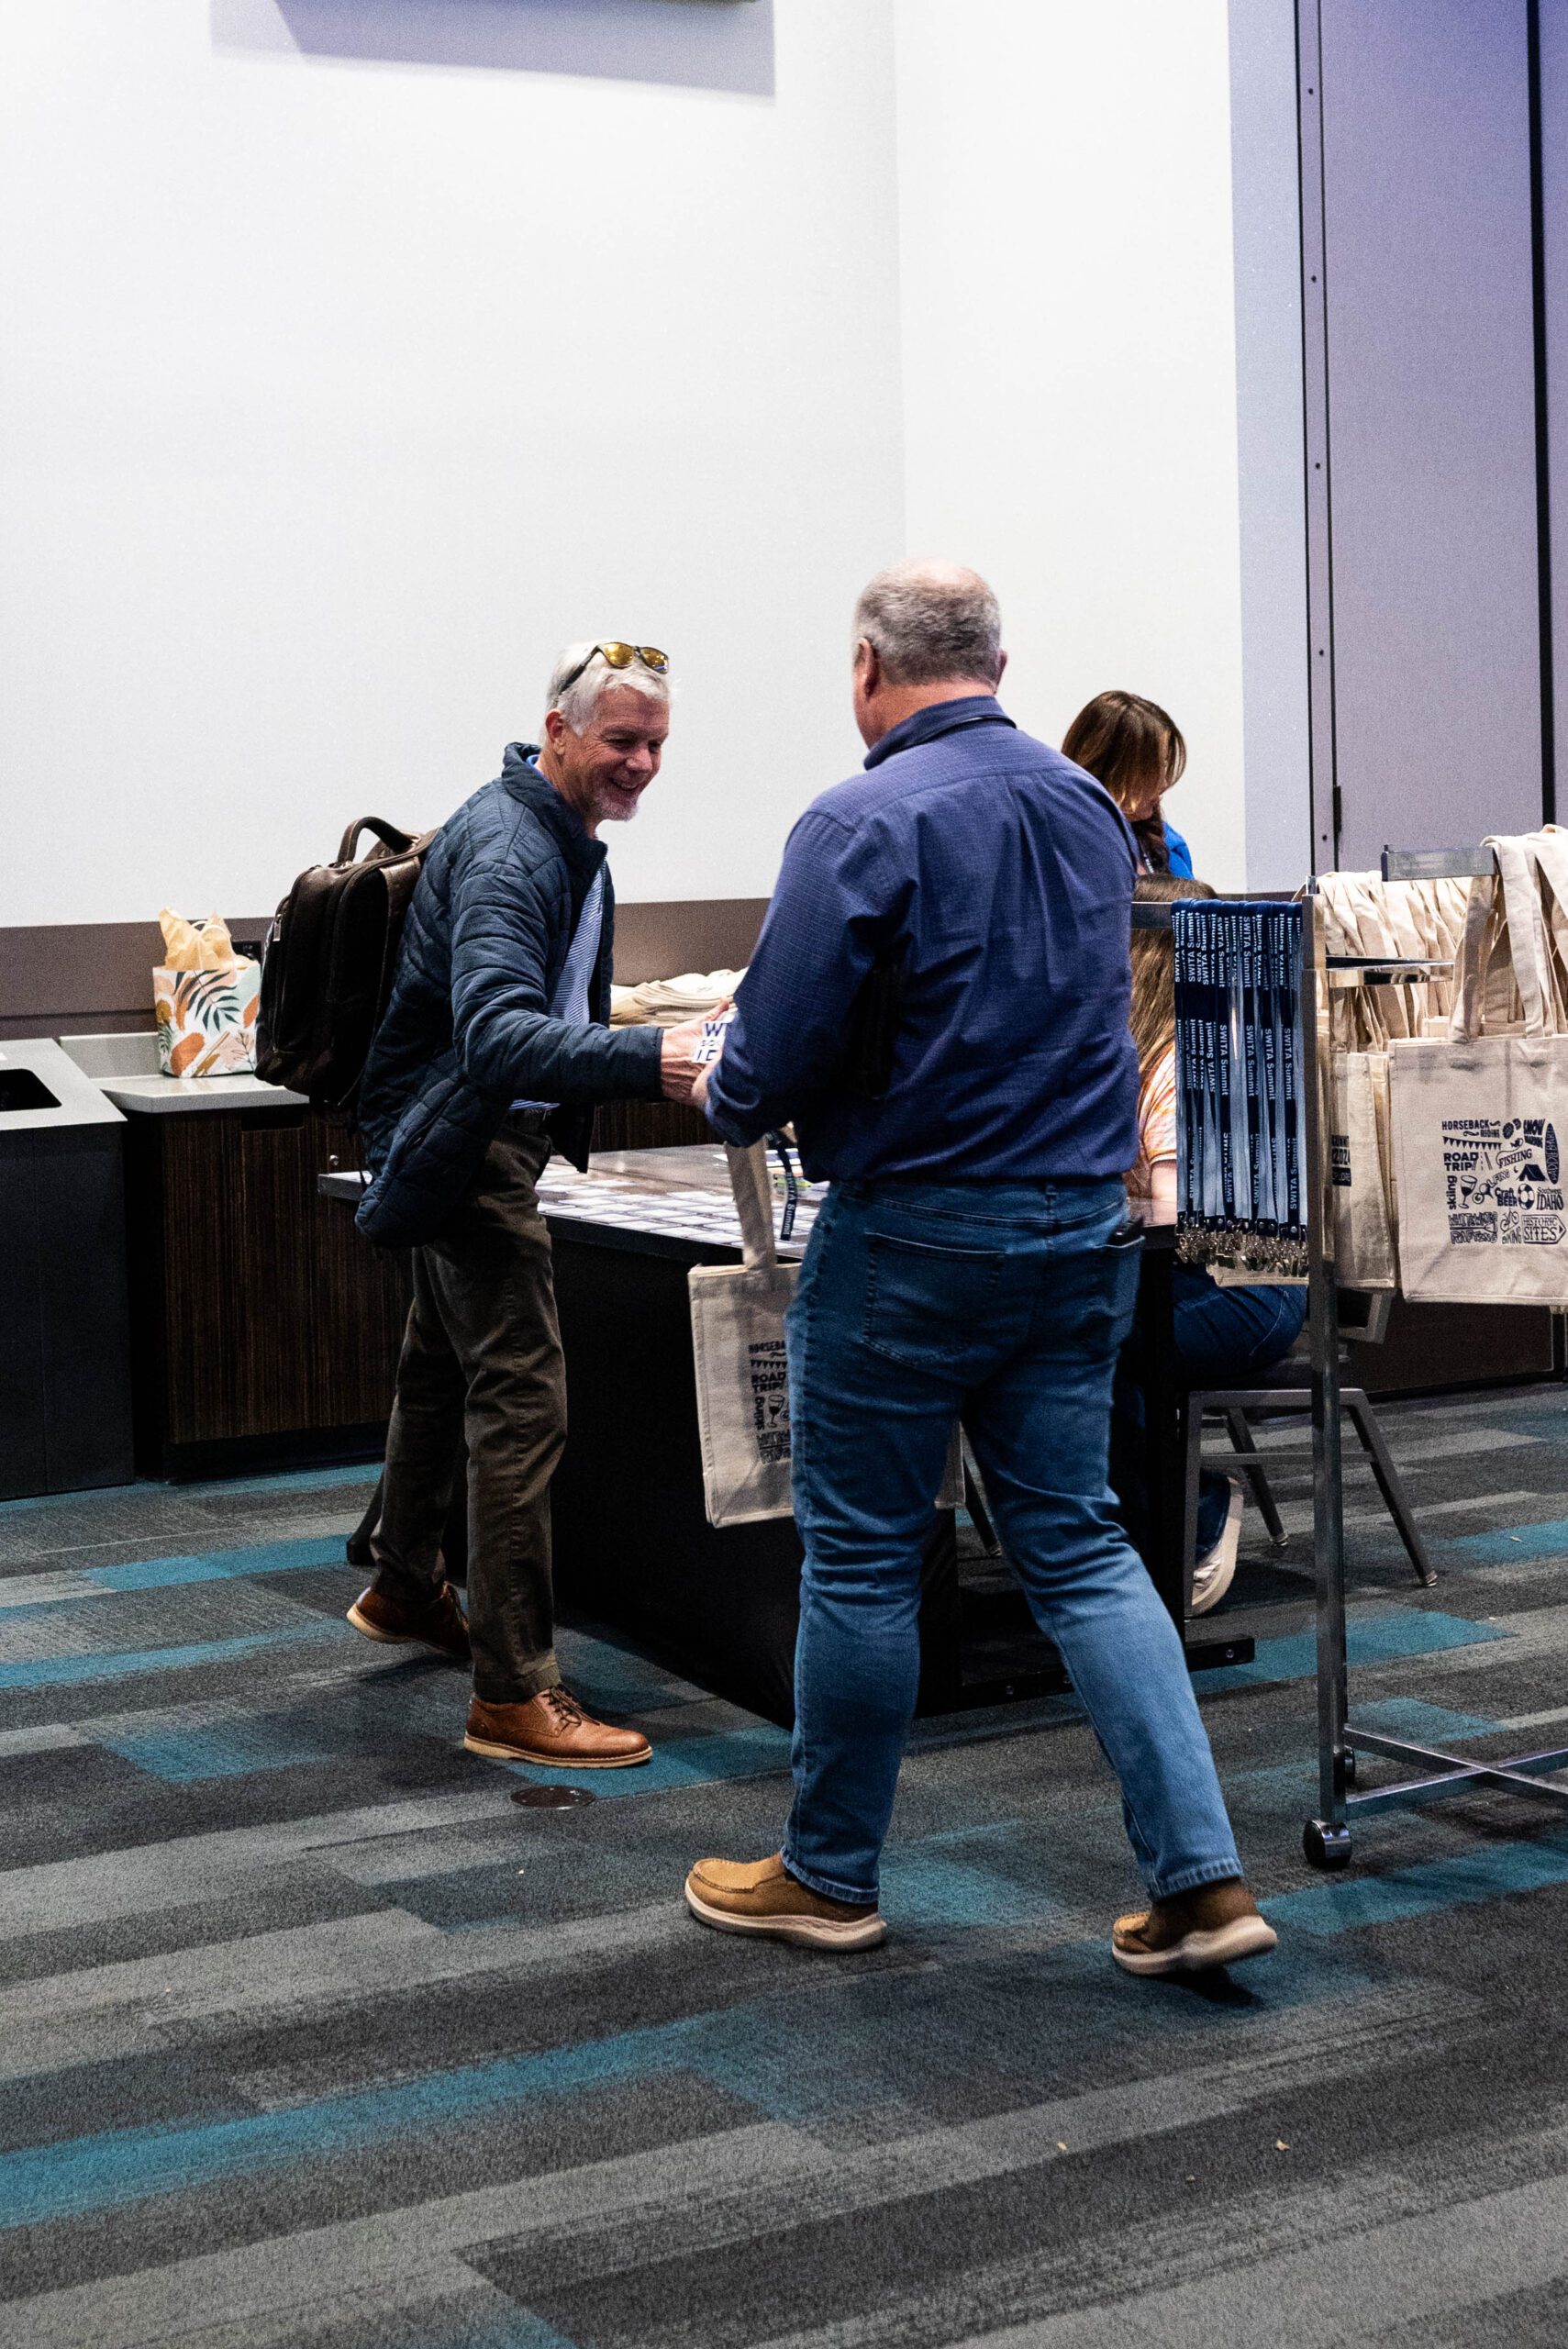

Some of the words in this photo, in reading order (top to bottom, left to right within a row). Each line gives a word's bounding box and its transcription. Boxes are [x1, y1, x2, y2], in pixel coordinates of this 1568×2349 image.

[1186, 912, 1195, 949] Summit
[1217, 917, 1225, 949] SWITA
[1243, 916, 1251, 949] SWITA
[1187, 951, 1196, 983] SWITA
[1201, 953, 1209, 985] SWITA
[1218, 951, 1226, 988] Summit
[1243, 951, 1252, 988] Summit
[1205, 1021, 1214, 1059] Summit
[1219, 1024, 1229, 1056] SWITA
[1246, 1025, 1255, 1057] SWITA
[1265, 1029, 1273, 1061] SWITA
[1221, 1059, 1229, 1096] Summit
[1266, 1063, 1275, 1100] Summit
[1441, 1119, 1490, 1130] HORSEBACK
[1290, 1138, 1298, 1175] Summit
[1443, 1152, 1479, 1163] ROAD
[1444, 1162, 1473, 1172] TRIP
[1498, 1148, 1532, 1169] FISHING
[1289, 1177, 1298, 1209] SWITA
[1446, 1175, 1458, 1209] skiing
[1497, 1196, 1518, 1207] BEER
[1536, 1194, 1564, 1210] IDAHO
[1523, 1217, 1558, 1226] HISTORIC
[1523, 1226, 1558, 1241] SITES
[751, 1372, 786, 1384] ROAD
[752, 1381, 784, 1394] TRIP
[754, 1396, 765, 1431] skiing
